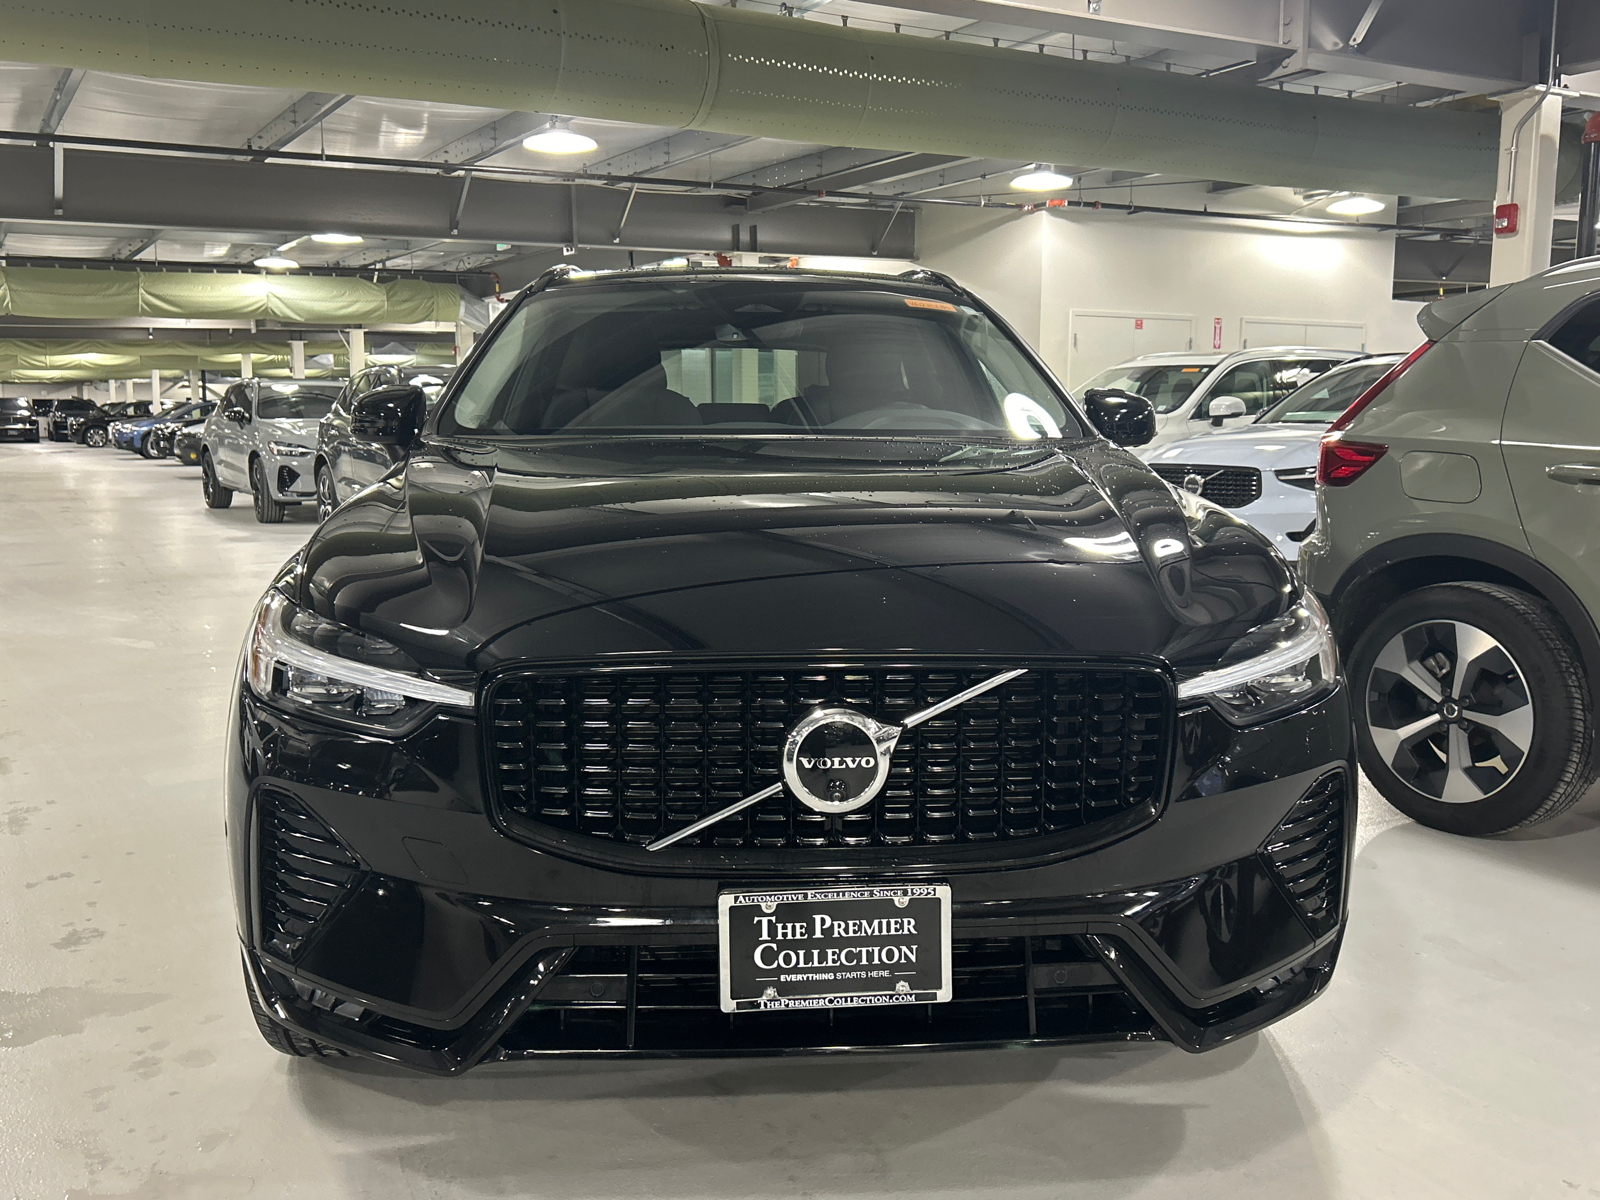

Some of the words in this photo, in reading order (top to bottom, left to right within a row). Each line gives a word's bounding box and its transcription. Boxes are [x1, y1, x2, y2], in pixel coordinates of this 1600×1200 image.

[799, 757, 875, 769] VOLVO
[736, 893, 804, 904] AUTOMOTIVE
[807, 891, 870, 900] EXCELLENCE
[873, 889, 903, 897] SINCE
[907, 887, 934, 896] 1995
[754, 916, 807, 940] THE
[812, 914, 917, 938] PREMIER
[754, 943, 918, 969] COLLECTION
[780, 973, 834, 982] EVERYTHING
[836, 971, 866, 980] STARTS
[868, 970, 892, 978] HERE.
